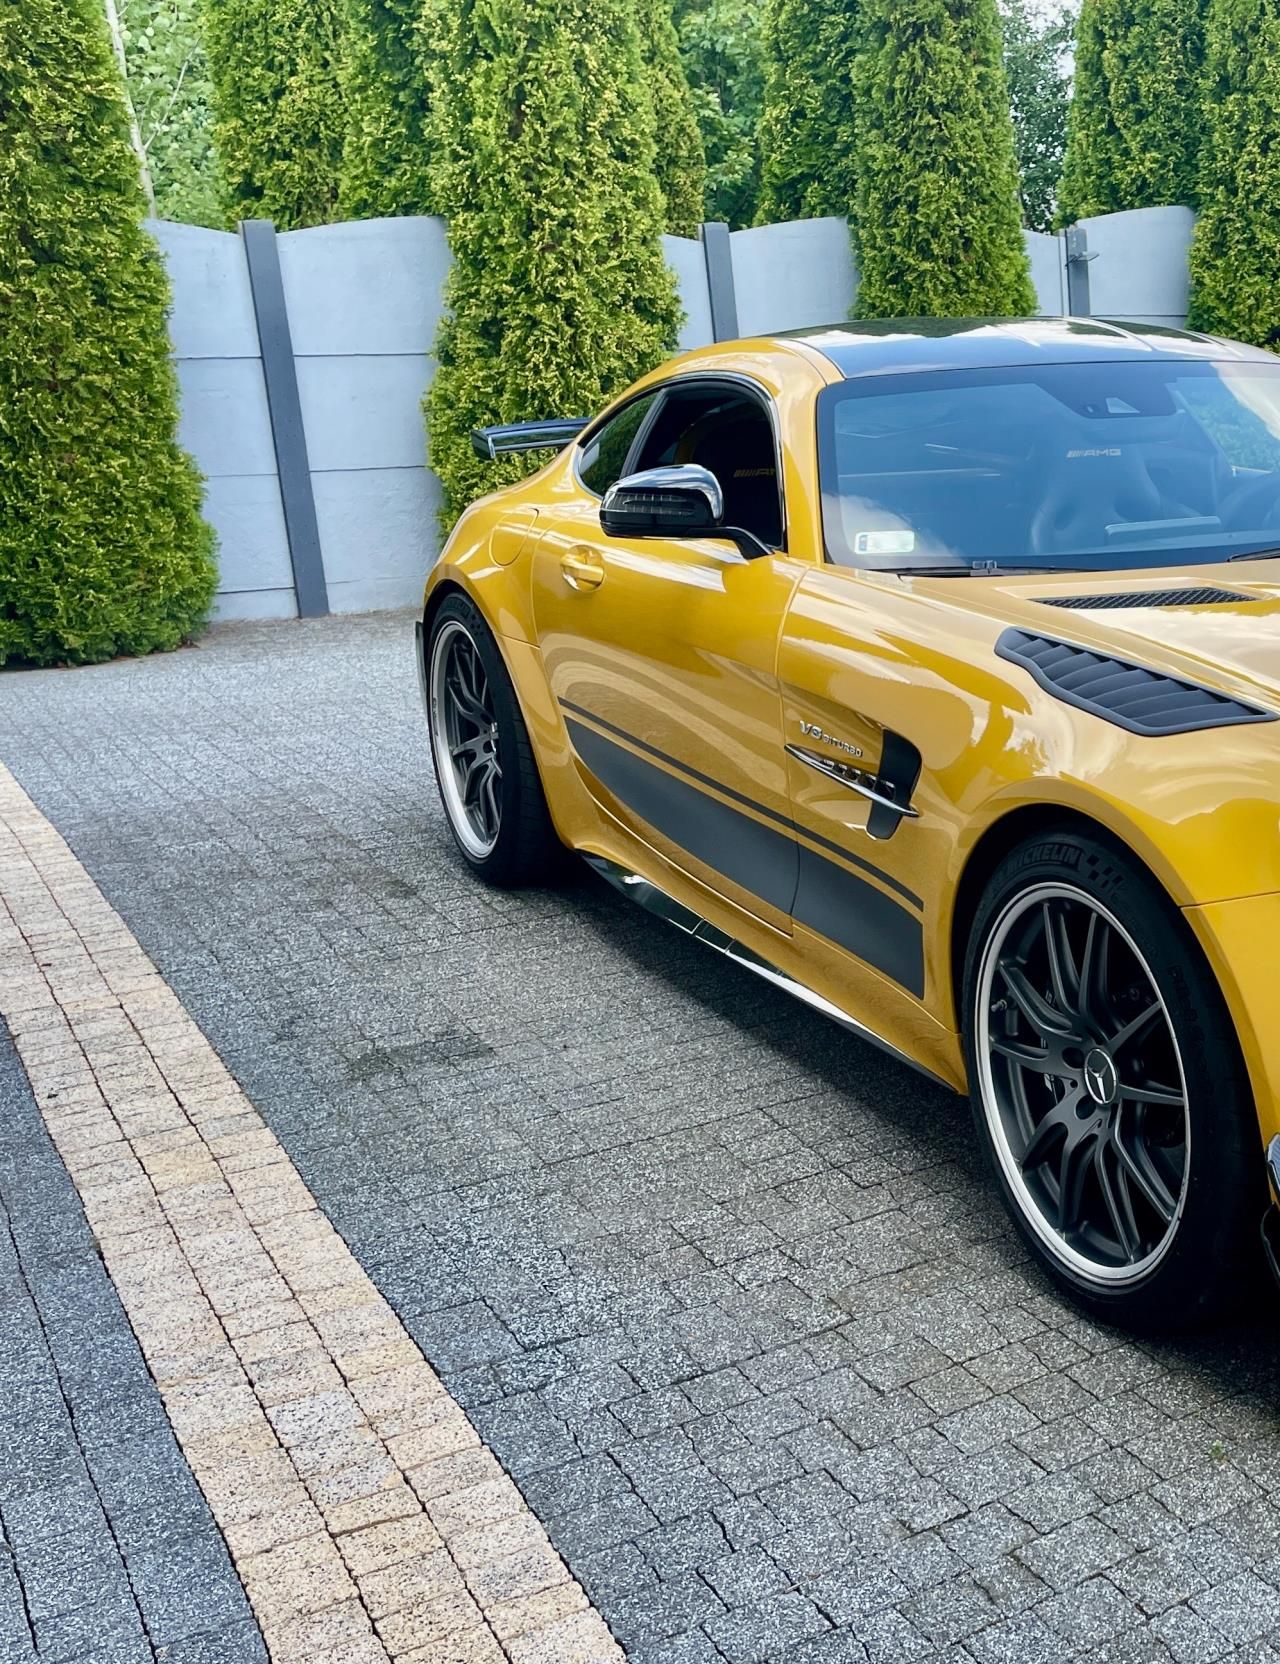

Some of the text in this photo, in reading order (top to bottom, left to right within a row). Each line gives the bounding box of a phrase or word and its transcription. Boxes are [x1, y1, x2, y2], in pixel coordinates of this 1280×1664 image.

[1083, 448, 1121, 457] AMG
[799, 720, 863, 758] V8 BITURBO
[1007, 843, 1081, 876] MICHELIN
